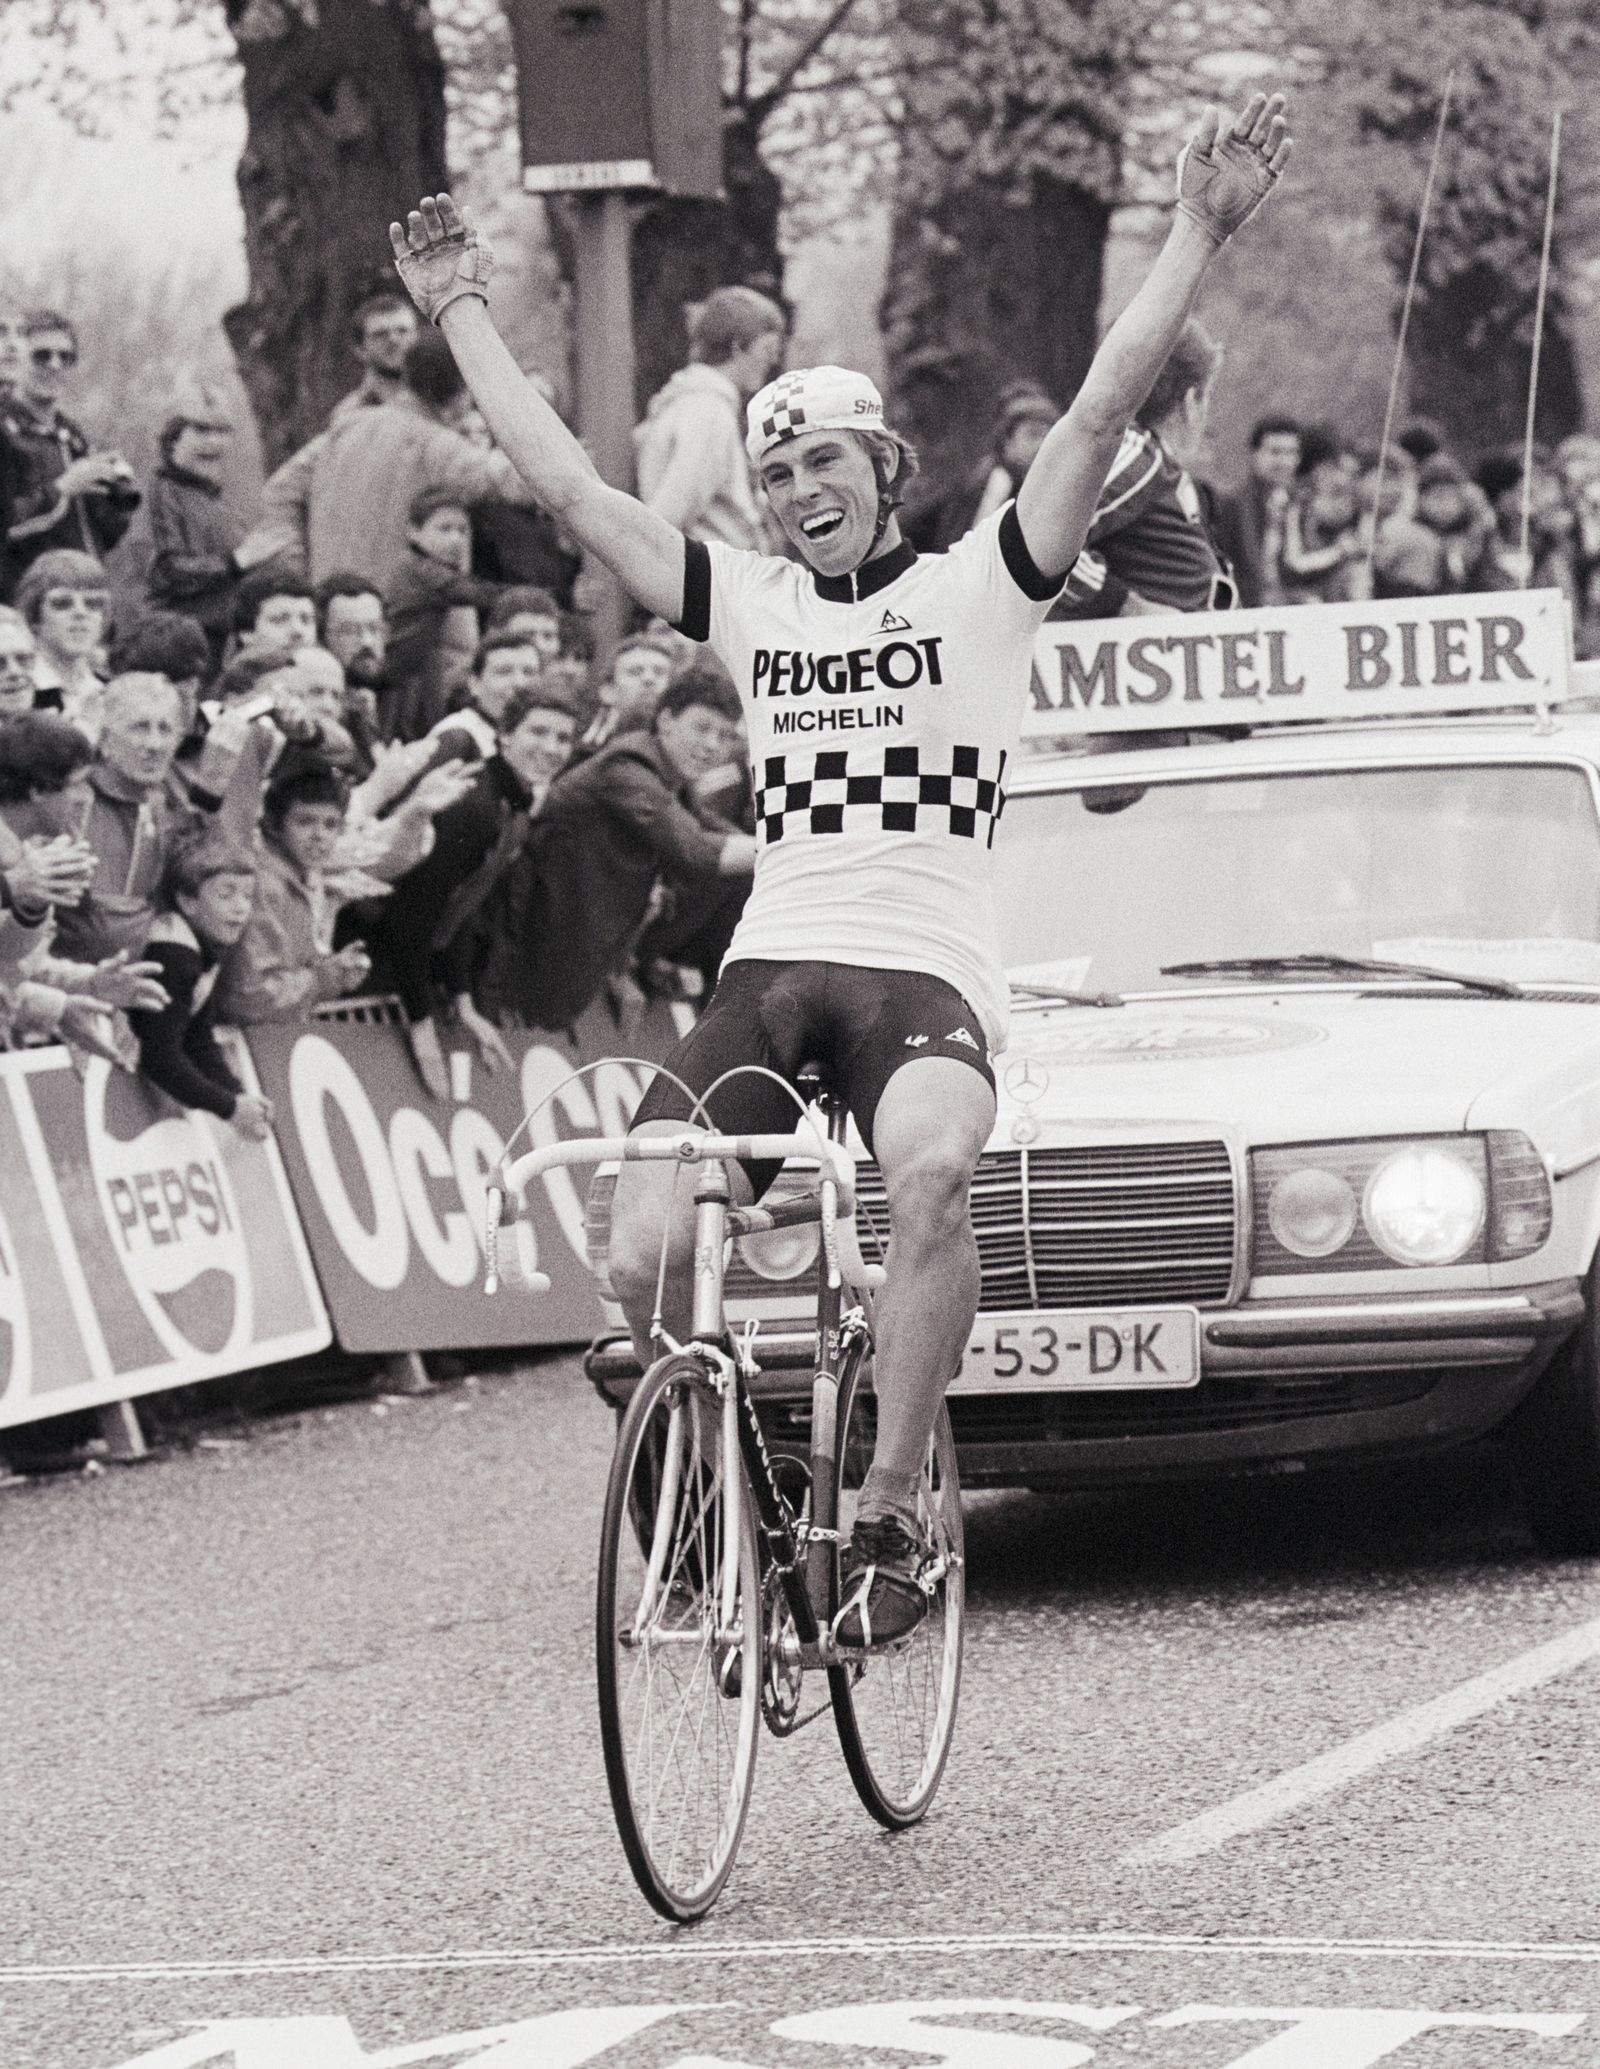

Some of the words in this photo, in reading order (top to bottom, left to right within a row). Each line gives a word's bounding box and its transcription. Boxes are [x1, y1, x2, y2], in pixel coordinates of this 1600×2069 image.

[753, 637, 942, 699] PEUGEOT
[1342, 615, 1535, 691] BIER
[773, 704, 903, 735] MICHELIN
[107, 1161, 233, 1253] PEPSI
[953, 1322, 1168, 1378] -53-DK
